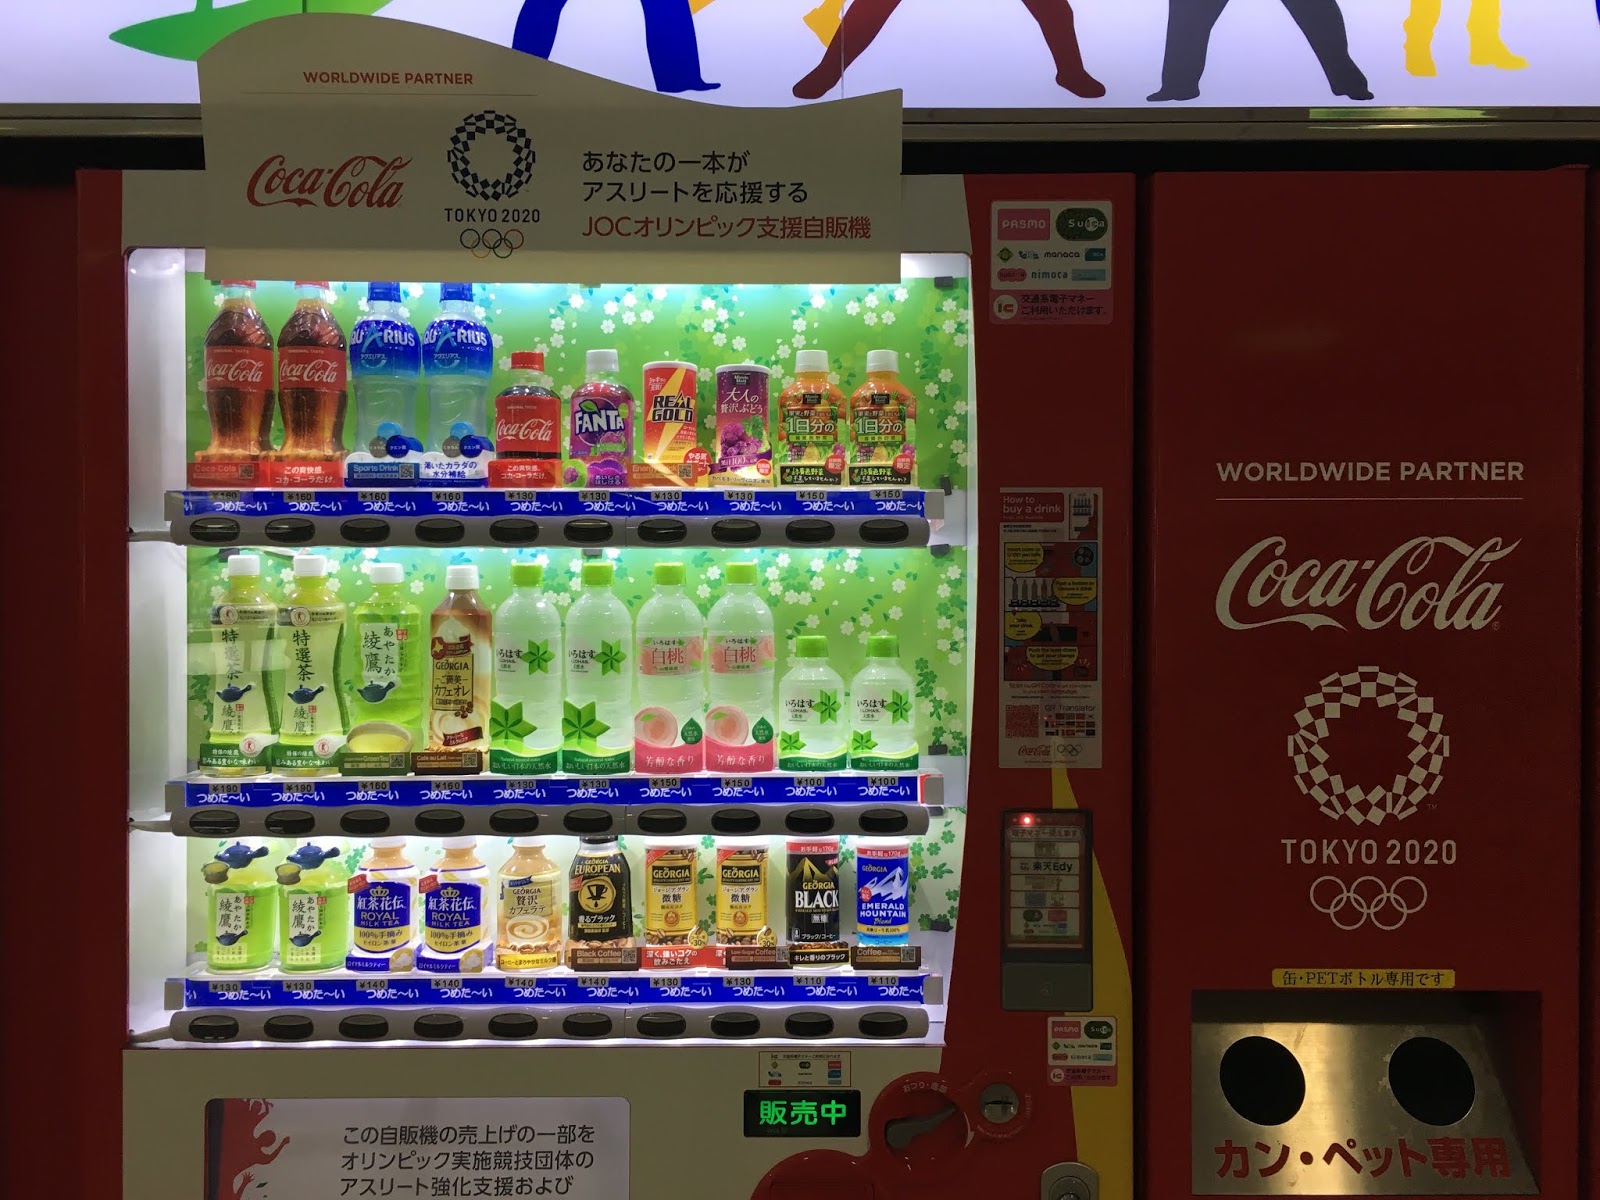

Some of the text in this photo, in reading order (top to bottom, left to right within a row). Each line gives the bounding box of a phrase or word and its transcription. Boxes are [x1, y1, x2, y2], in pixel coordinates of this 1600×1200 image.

[303, 71, 474, 85] WORLDWIDE PARTNER
[582, 150, 750, 174] あなたの一本が
[247, 155, 413, 208] Coca-Cola
[582, 181, 808, 204] アスリートを応援する
[444, 208, 540, 223] TOKYO 2020
[582, 215, 872, 239] JOCオリンピック支援自販機
[1002, 217, 1105, 231] PASMO Suica
[1031, 270, 1068, 279] nimoca
[652, 391, 693, 409] REAL
[725, 387, 759, 403] 大人の
[721, 403, 763, 414] 贅沢ぶどう
[652, 409, 693, 423] GOLD
[575, 409, 625, 435] FANTA
[786, 417, 835, 434] 1日分の
[856, 417, 903, 434] 1日分の
[353, 464, 399, 472] Sports Drink
[1216, 461, 1524, 481] WORLDWIDE PARTNER
[212, 492, 237, 500] ¥160
[287, 493, 312, 501] ¥160
[508, 492, 534, 500] ¥130
[582, 492, 607, 500] ¥130
[654, 492, 680, 500] ¥130
[727, 492, 753, 500] ¥130
[800, 491, 825, 500] ¥150
[874, 490, 901, 498] ¥150
[1003, 496, 1023, 504] How
[1003, 504, 1023, 515] buy
[1034, 504, 1062, 514] drink
[1215, 535, 1522, 632] Coca-Cola
[293, 629, 315, 682] 特選茶
[362, 631, 383, 674] 綾鷹
[383, 626, 396, 676] あやたか
[651, 647, 684, 665] 白桃
[723, 646, 756, 663] 白桃
[435, 660, 470, 670] GEORGIA
[434, 685, 471, 697] カフェオレ
[785, 699, 815, 708] いろはす
[857, 699, 887, 708] いろはす
[1059, 704, 1096, 712] Translator
[645, 755, 695, 767] 芳醇な香り
[715, 754, 766, 766] 芳醇な香り
[361, 782, 387, 790] ¥160
[435, 782, 461, 790] ¥160
[508, 780, 534, 789] ¥130
[582, 780, 607, 788] ¥130
[652, 778, 677, 787] ¥150
[724, 778, 750, 788] ¥150
[796, 778, 823, 786] ¥100
[870, 777, 896, 786] ¥100
[212, 784, 238, 792] ¥190
[286, 784, 312, 792] ¥190
[1281, 839, 1457, 864] TOKYO 2020
[575, 864, 621, 875] EUROPEAN
[861, 864, 888, 873] GEORGIA
[1032, 861, 1073, 872] 楽天Edy
[653, 867, 691, 878] GEORGIA
[722, 867, 760, 878] GEORGIA
[802, 880, 835, 890] GEORGIA
[512, 887, 542, 895] GEORGIA
[516, 895, 538, 906] 贅沢
[662, 893, 682, 903] 微糖
[730, 893, 750, 903] 微糖
[795, 889, 840, 908] BLACK
[357, 896, 404, 911] 紅茶花伝
[428, 896, 474, 912] 紅茶花伝
[861, 902, 905, 910] EMERALD
[218, 899, 233, 928] 綾鷹
[233, 896, 243, 931] あやたか
[291, 900, 307, 929] 綾鷹
[306, 896, 316, 931] あやたか
[508, 905, 546, 915] カフェラテ
[859, 910, 906, 918] MOUNTAIN
[360, 911, 400, 920] ROYAL
[431, 911, 470, 921] ROYAL
[578, 915, 616, 923] 香るブラック
[755, 948, 776, 956] Coffee
[857, 948, 882, 956] Coffee
[653, 958, 691, 966] 飲みごたえ
[434, 979, 460, 988] ¥140
[508, 978, 534, 987] ¥140
[581, 978, 607, 986] ¥140
[653, 977, 678, 986] ¥130
[726, 977, 752, 986] ¥130
[796, 976, 822, 985] ¥110
[871, 976, 897, 985] ¥110
[1282, 970, 1445, 987] 缶・PETボトル専用です
[212, 983, 238, 992] ¥130
[285, 982, 312, 991] ¥130
[360, 980, 386, 989] ¥140
[759, 1100, 846, 1125] 販売中
[342, 1123, 595, 1146] この自販機の売上げの一部を
[341, 1149, 594, 1172] オリンピック実施競技団体の
[1214, 1137, 1511, 1179] カン・ペット専用
[340, 1174, 574, 1197] アスリート強化支援および
